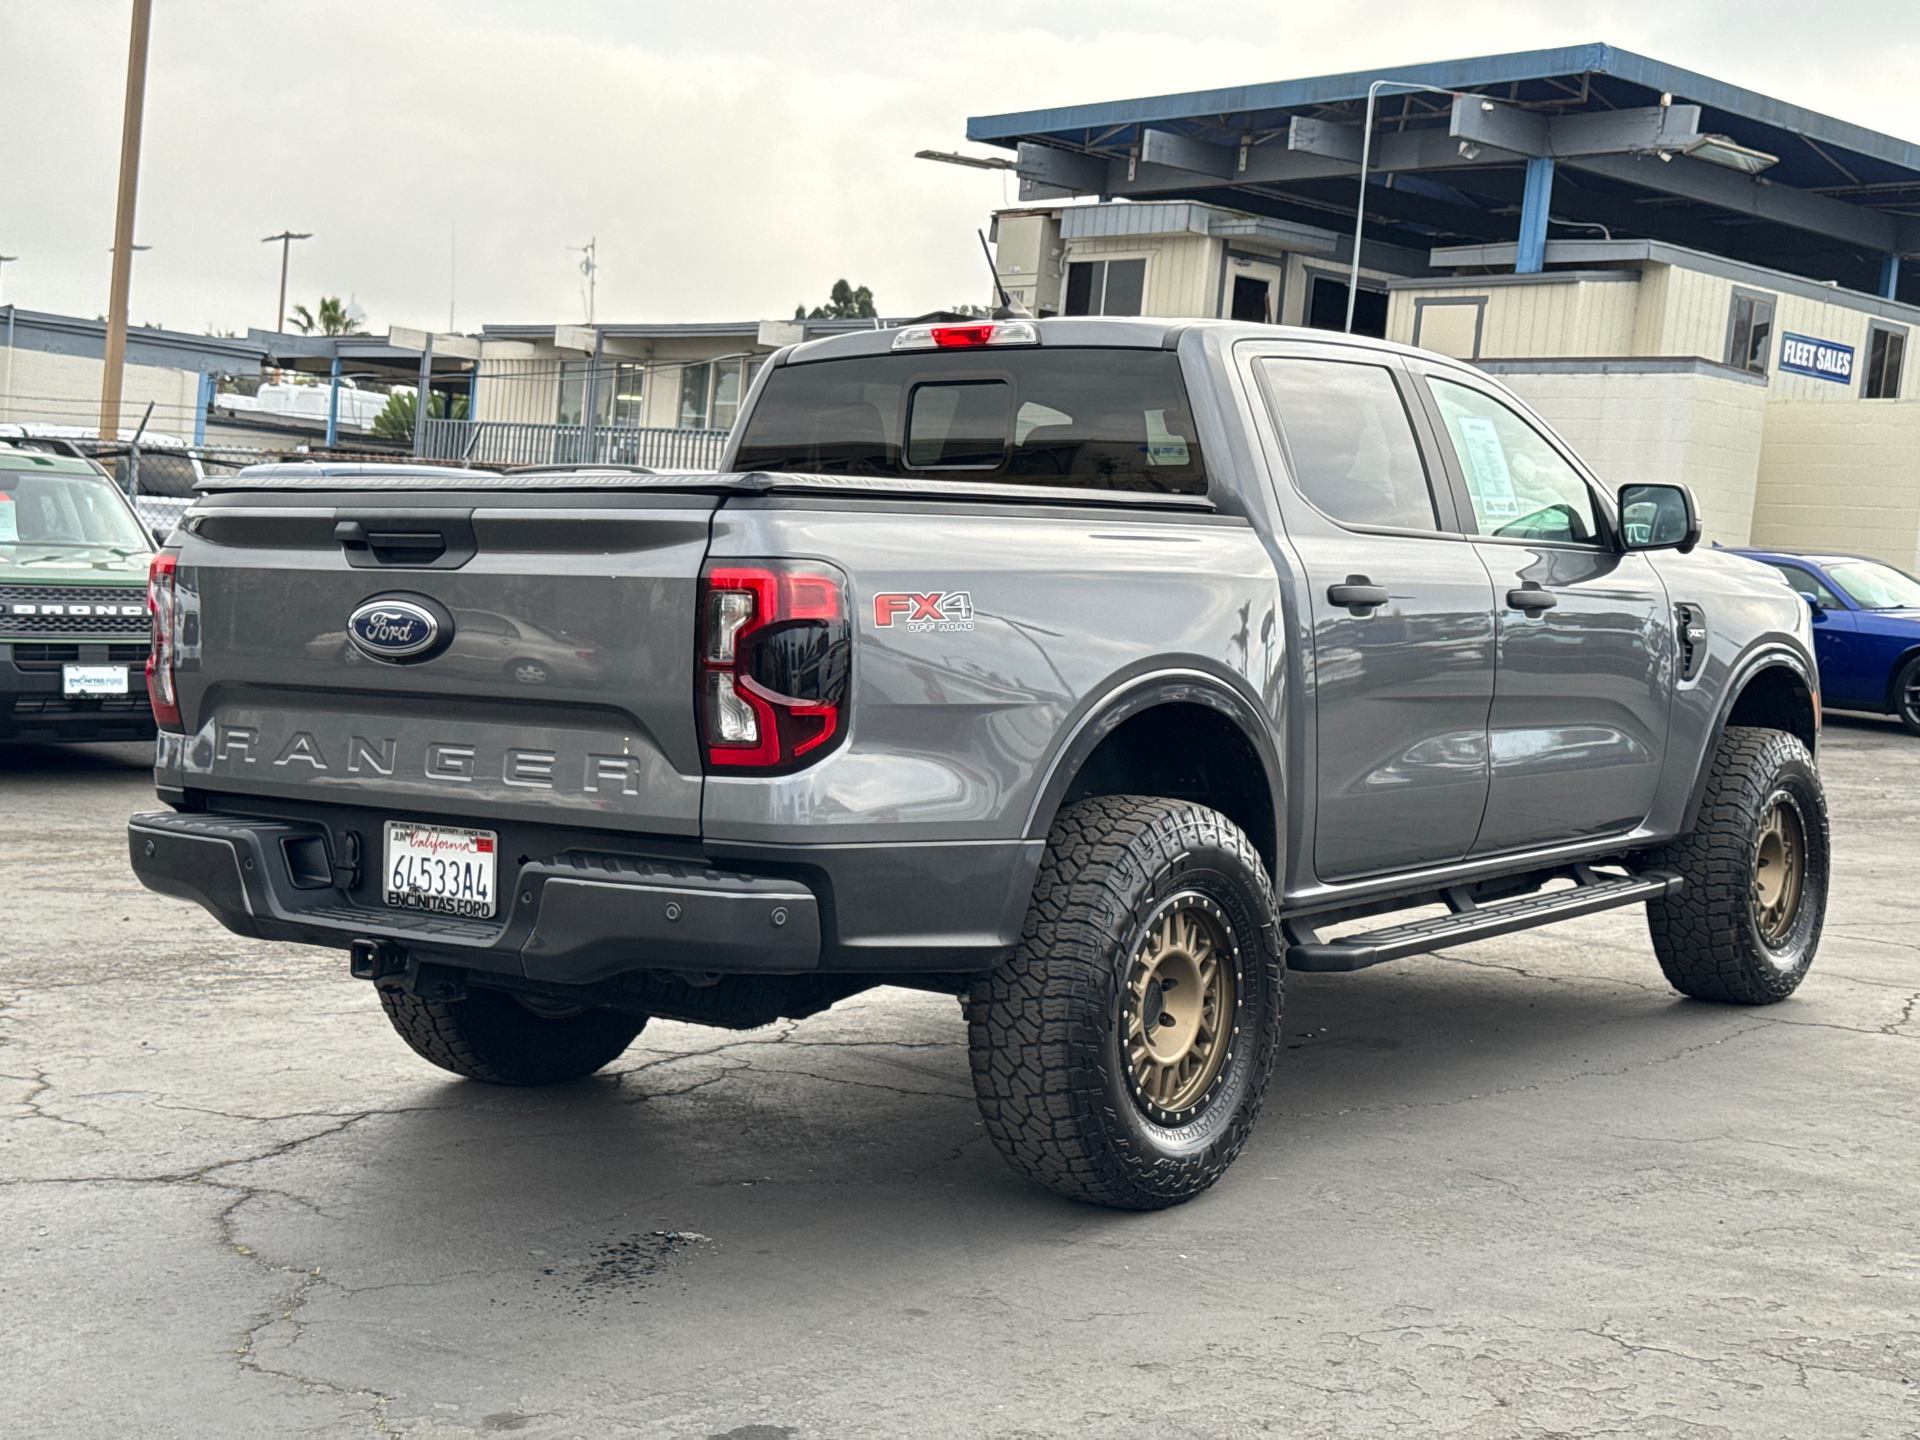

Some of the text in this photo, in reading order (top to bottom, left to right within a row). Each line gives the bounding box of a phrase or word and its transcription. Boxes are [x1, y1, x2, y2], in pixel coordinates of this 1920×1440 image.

[1783, 339, 1851, 376] FLEET SALES
[13, 604, 153, 616] BRONC
[873, 591, 974, 628] FX4
[366, 611, 414, 642] Ford
[908, 621, 975, 632] OFF ROAD
[216, 725, 641, 796] RANGER
[400, 823, 414, 831] DON'T
[439, 827, 459, 835] SATISFY
[463, 829, 478, 837] SINCE
[410, 830, 478, 855] California
[393, 854, 488, 901] 64533A4
[388, 892, 490, 918] ENCINITAS FORD
